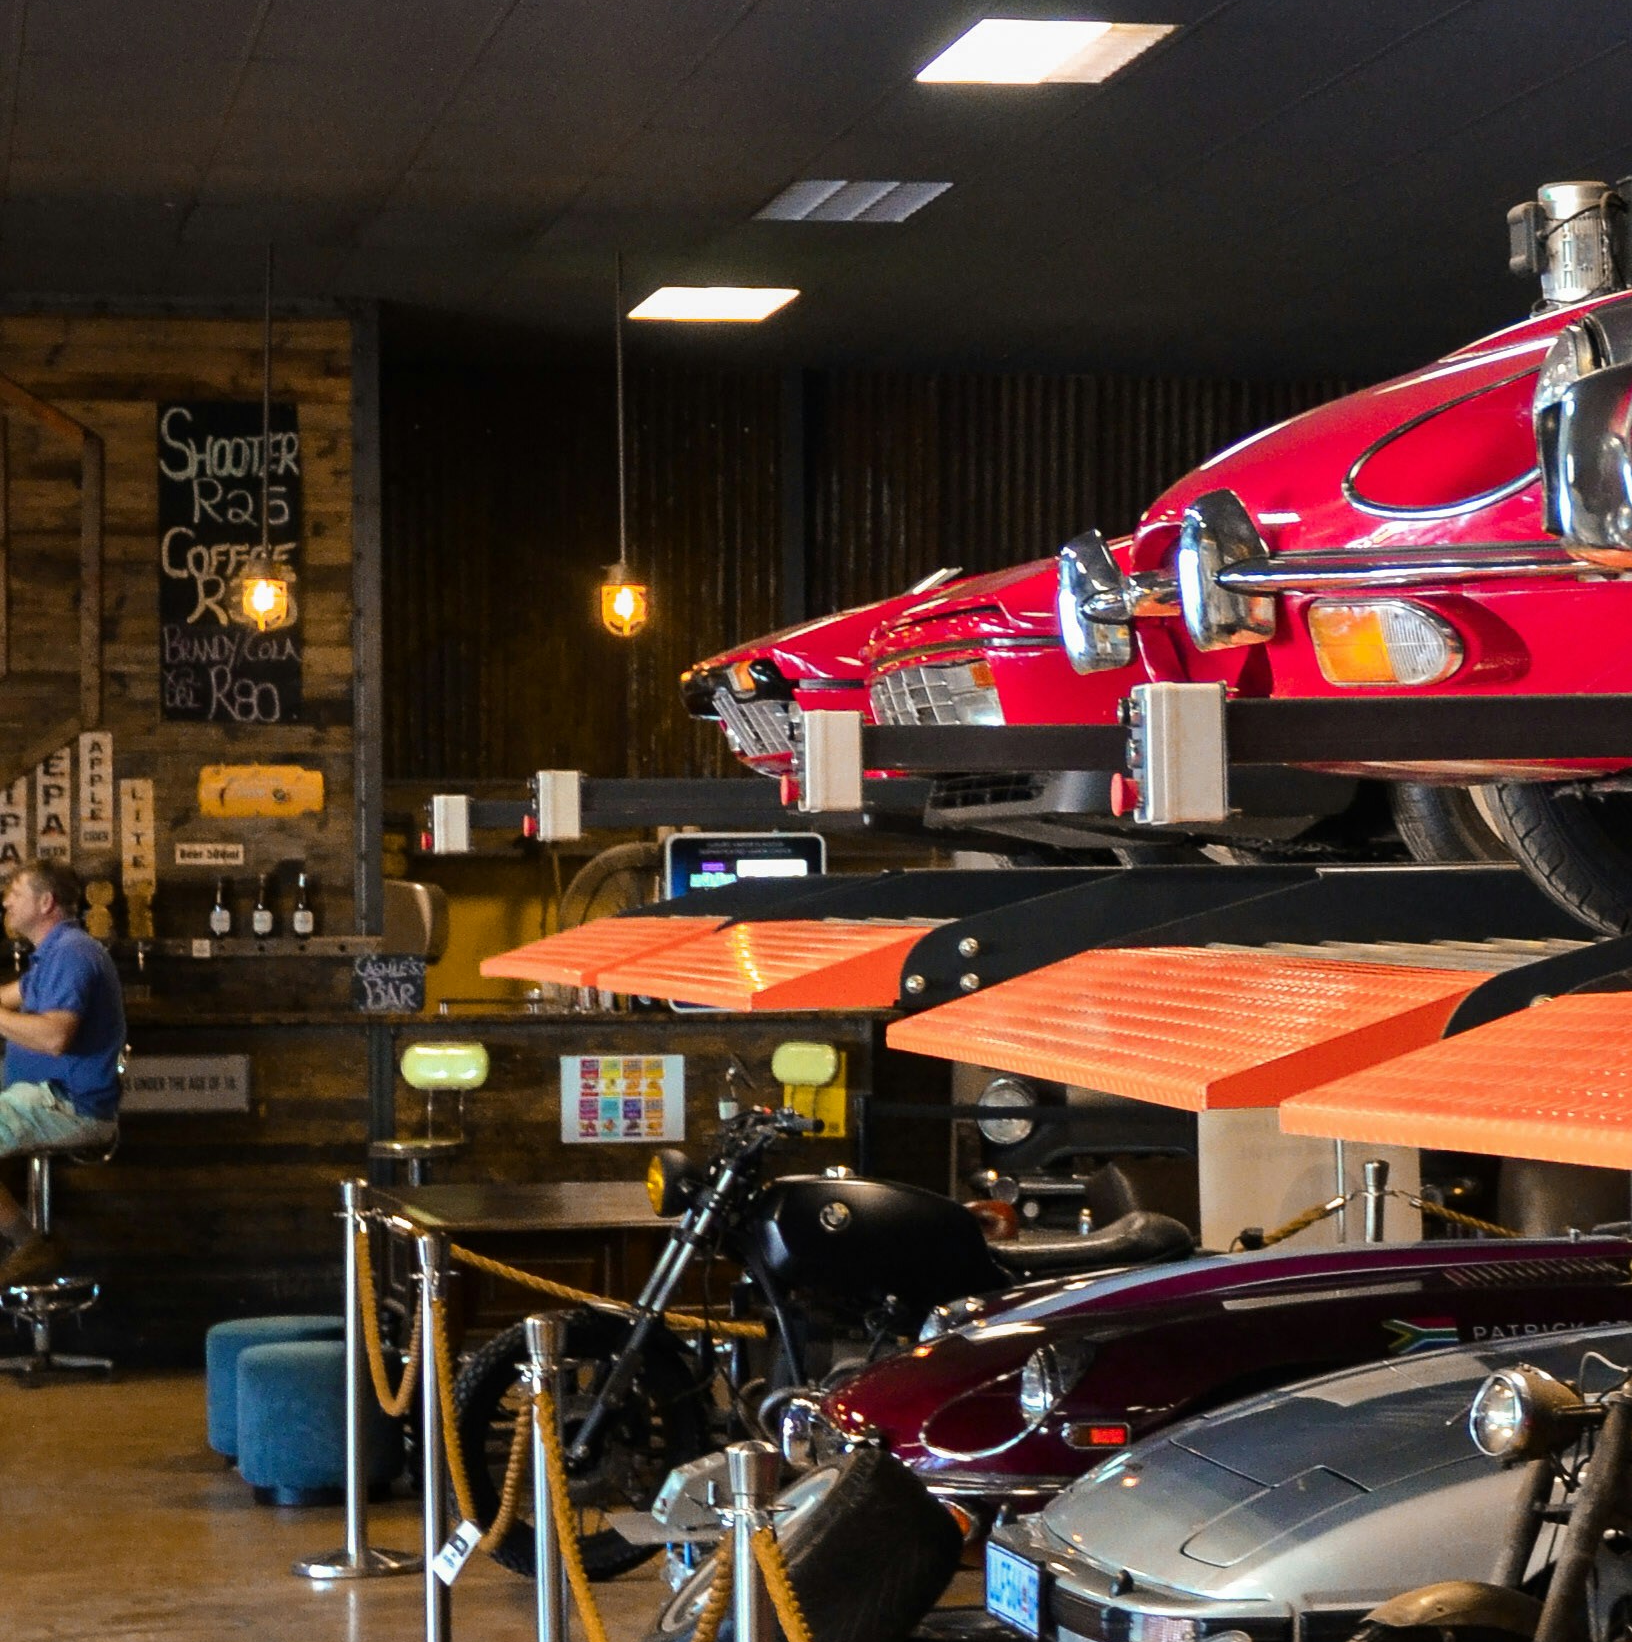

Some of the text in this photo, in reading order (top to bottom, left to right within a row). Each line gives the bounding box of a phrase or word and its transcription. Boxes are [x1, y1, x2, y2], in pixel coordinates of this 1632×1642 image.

[160, 407, 299, 481] SHOOTER
[193, 478, 290, 527] R25
[208, 665, 281, 722] R80
[89, 741, 103, 821] APPLE
[130, 788, 145, 868] LITE
[363, 977, 418, 1010] BAR
